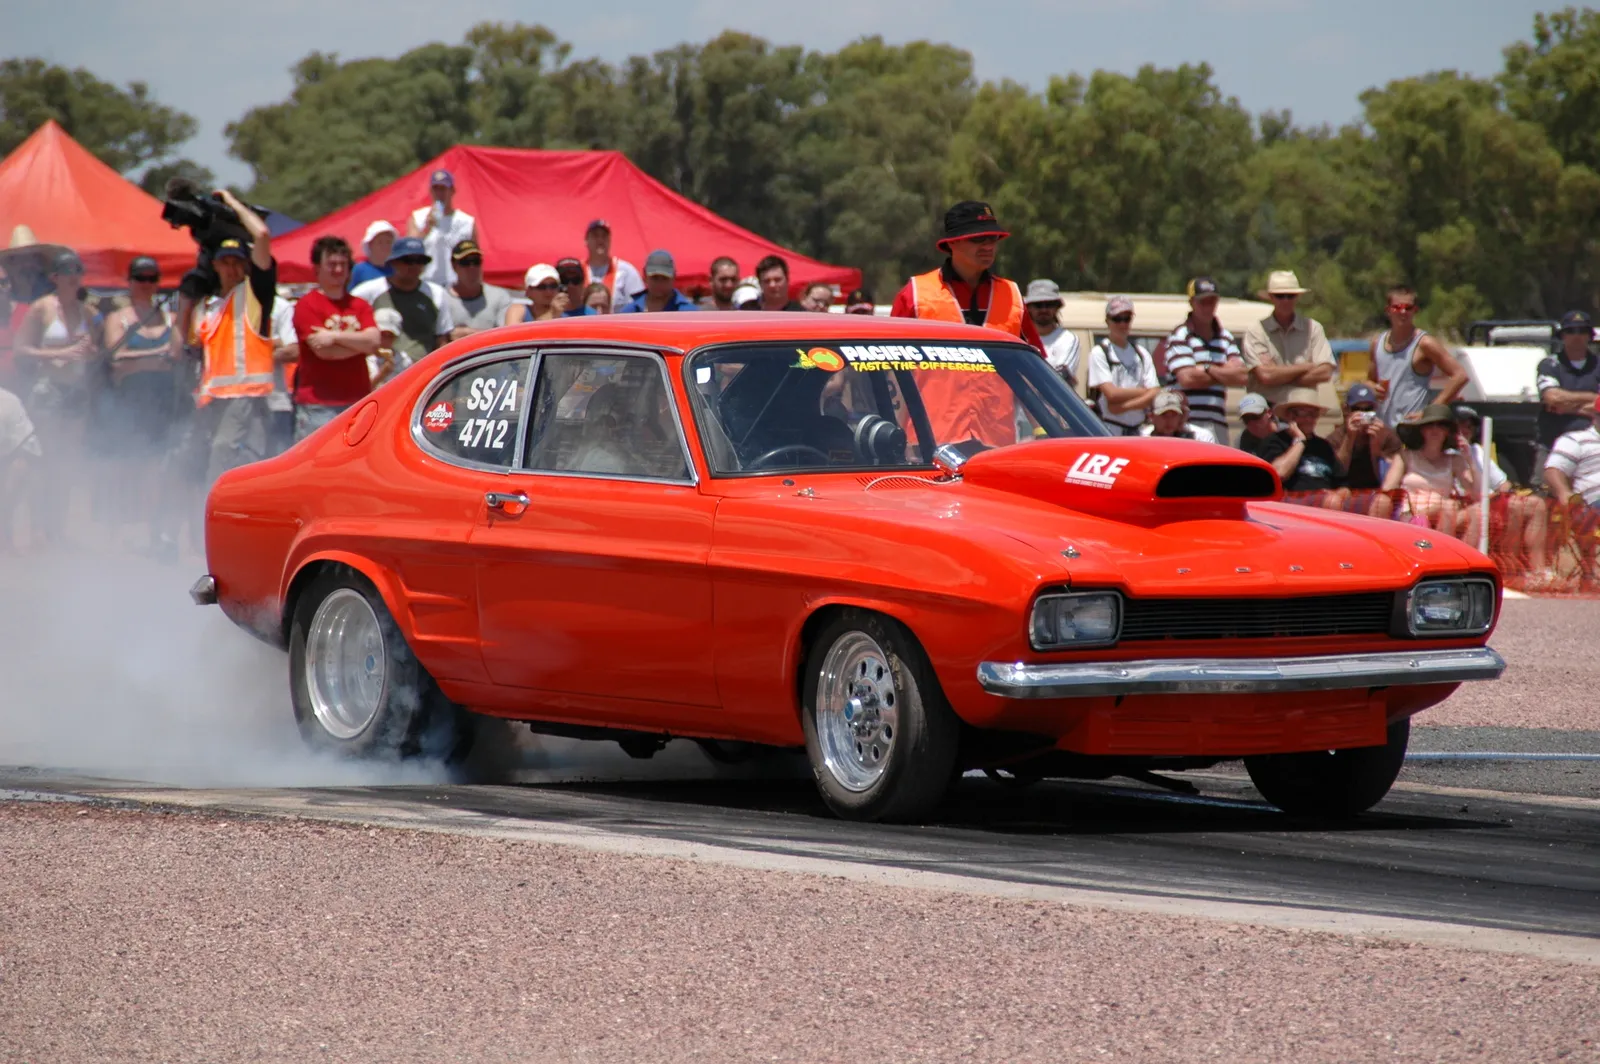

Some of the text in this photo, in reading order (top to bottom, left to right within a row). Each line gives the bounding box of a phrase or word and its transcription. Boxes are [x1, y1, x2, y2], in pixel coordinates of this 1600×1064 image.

[839, 345, 992, 363] PACIFIC FRESH
[849, 361, 996, 373] TASTE THE DIFFERENCE
[467, 377, 518, 418] SS/A
[458, 418, 508, 449] 4712
